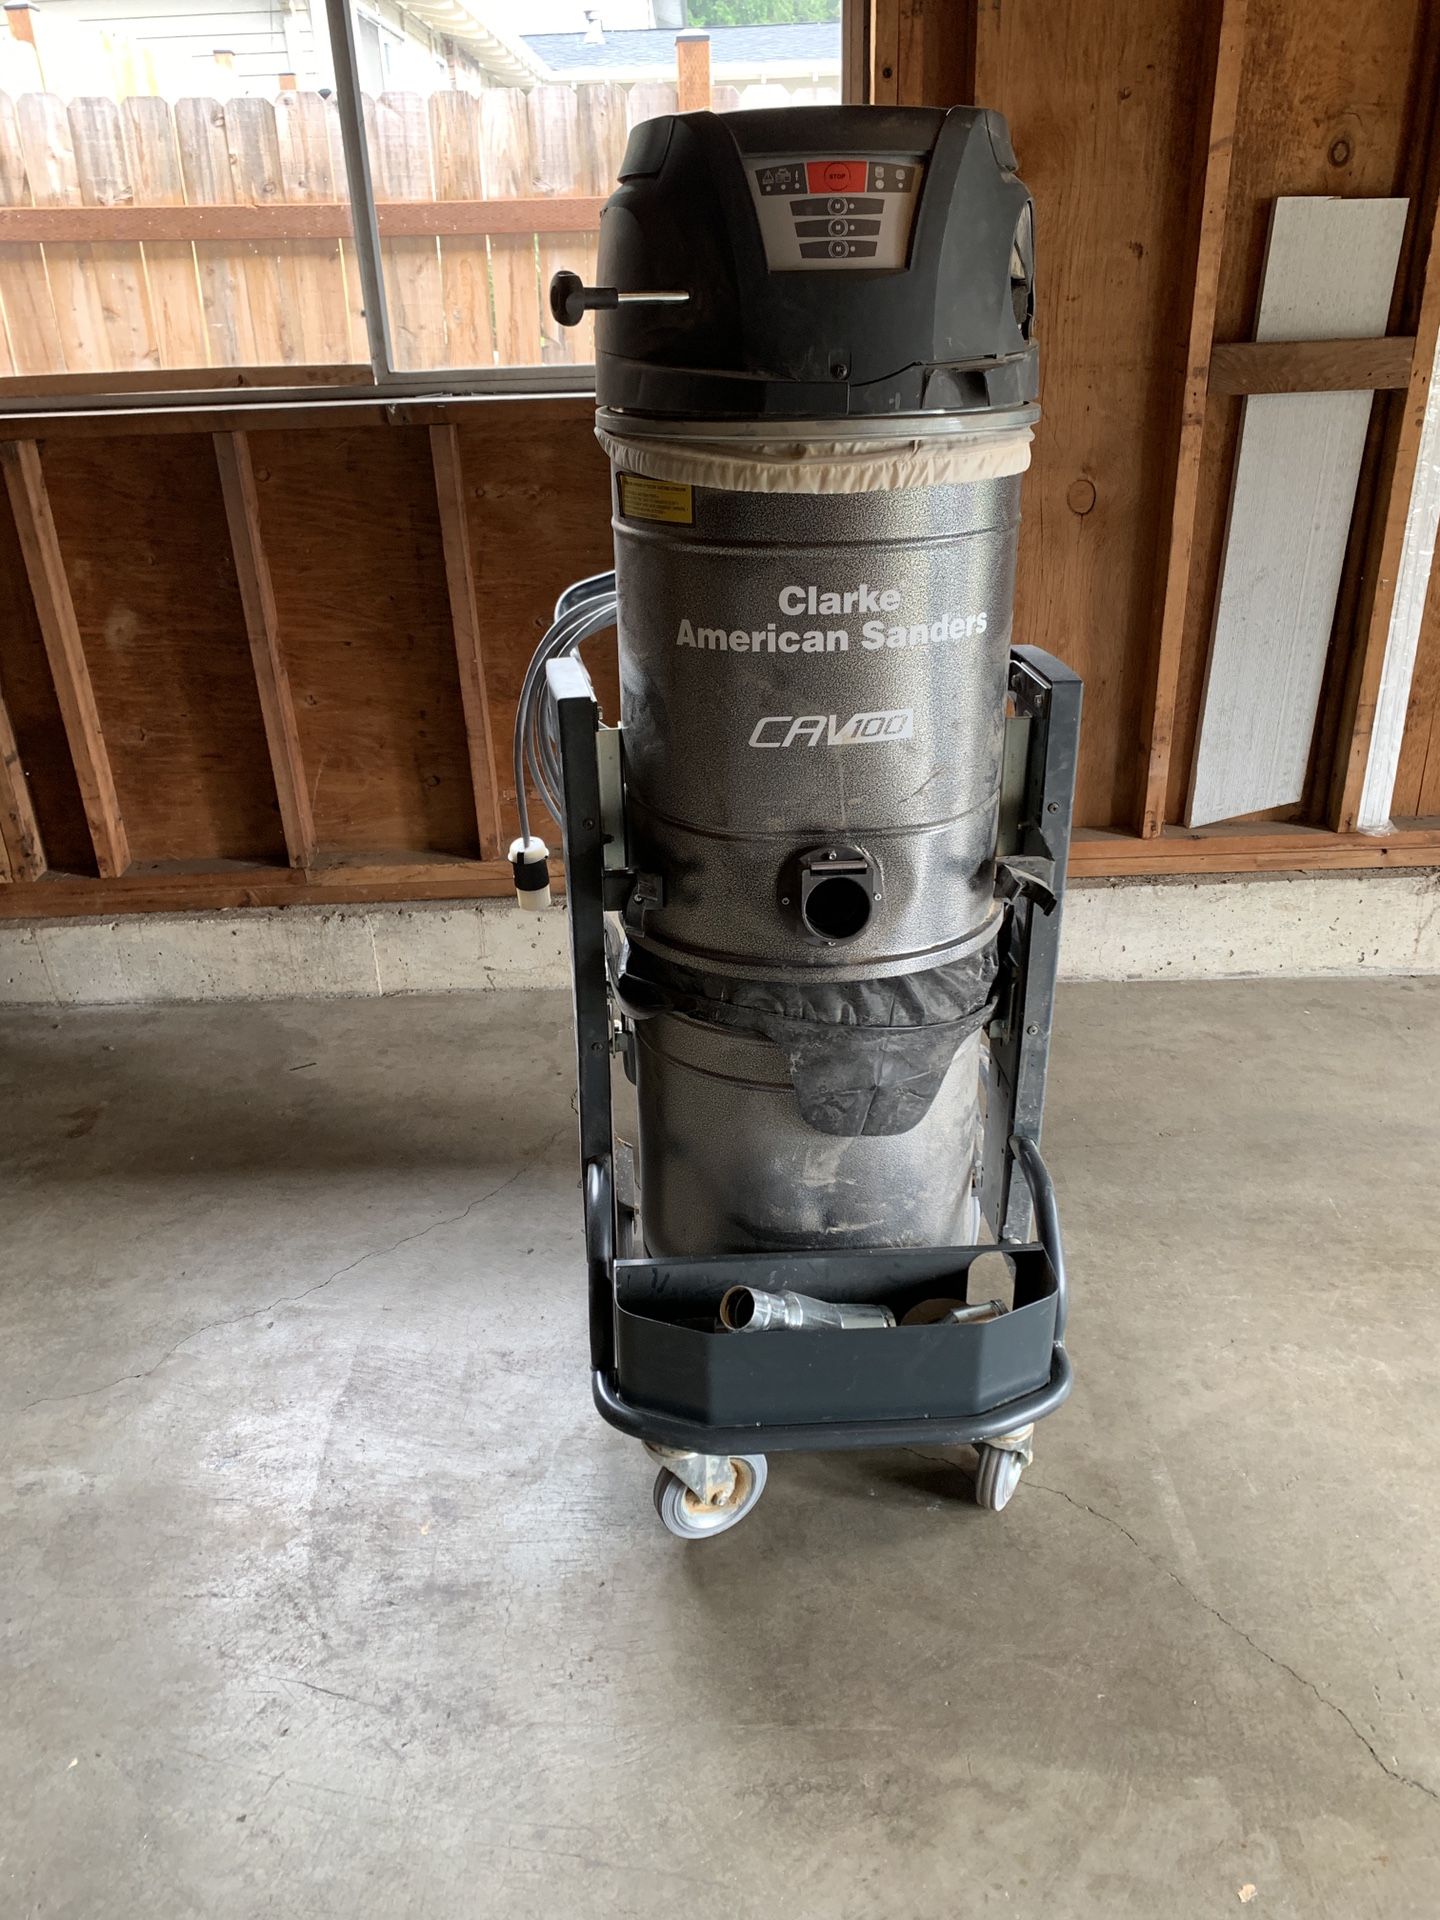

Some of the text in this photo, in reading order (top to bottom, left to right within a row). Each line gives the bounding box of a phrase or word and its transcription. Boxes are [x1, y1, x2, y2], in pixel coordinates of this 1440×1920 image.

[778, 584, 901, 616] Clarke
[676, 612, 988, 653] American Sanders
